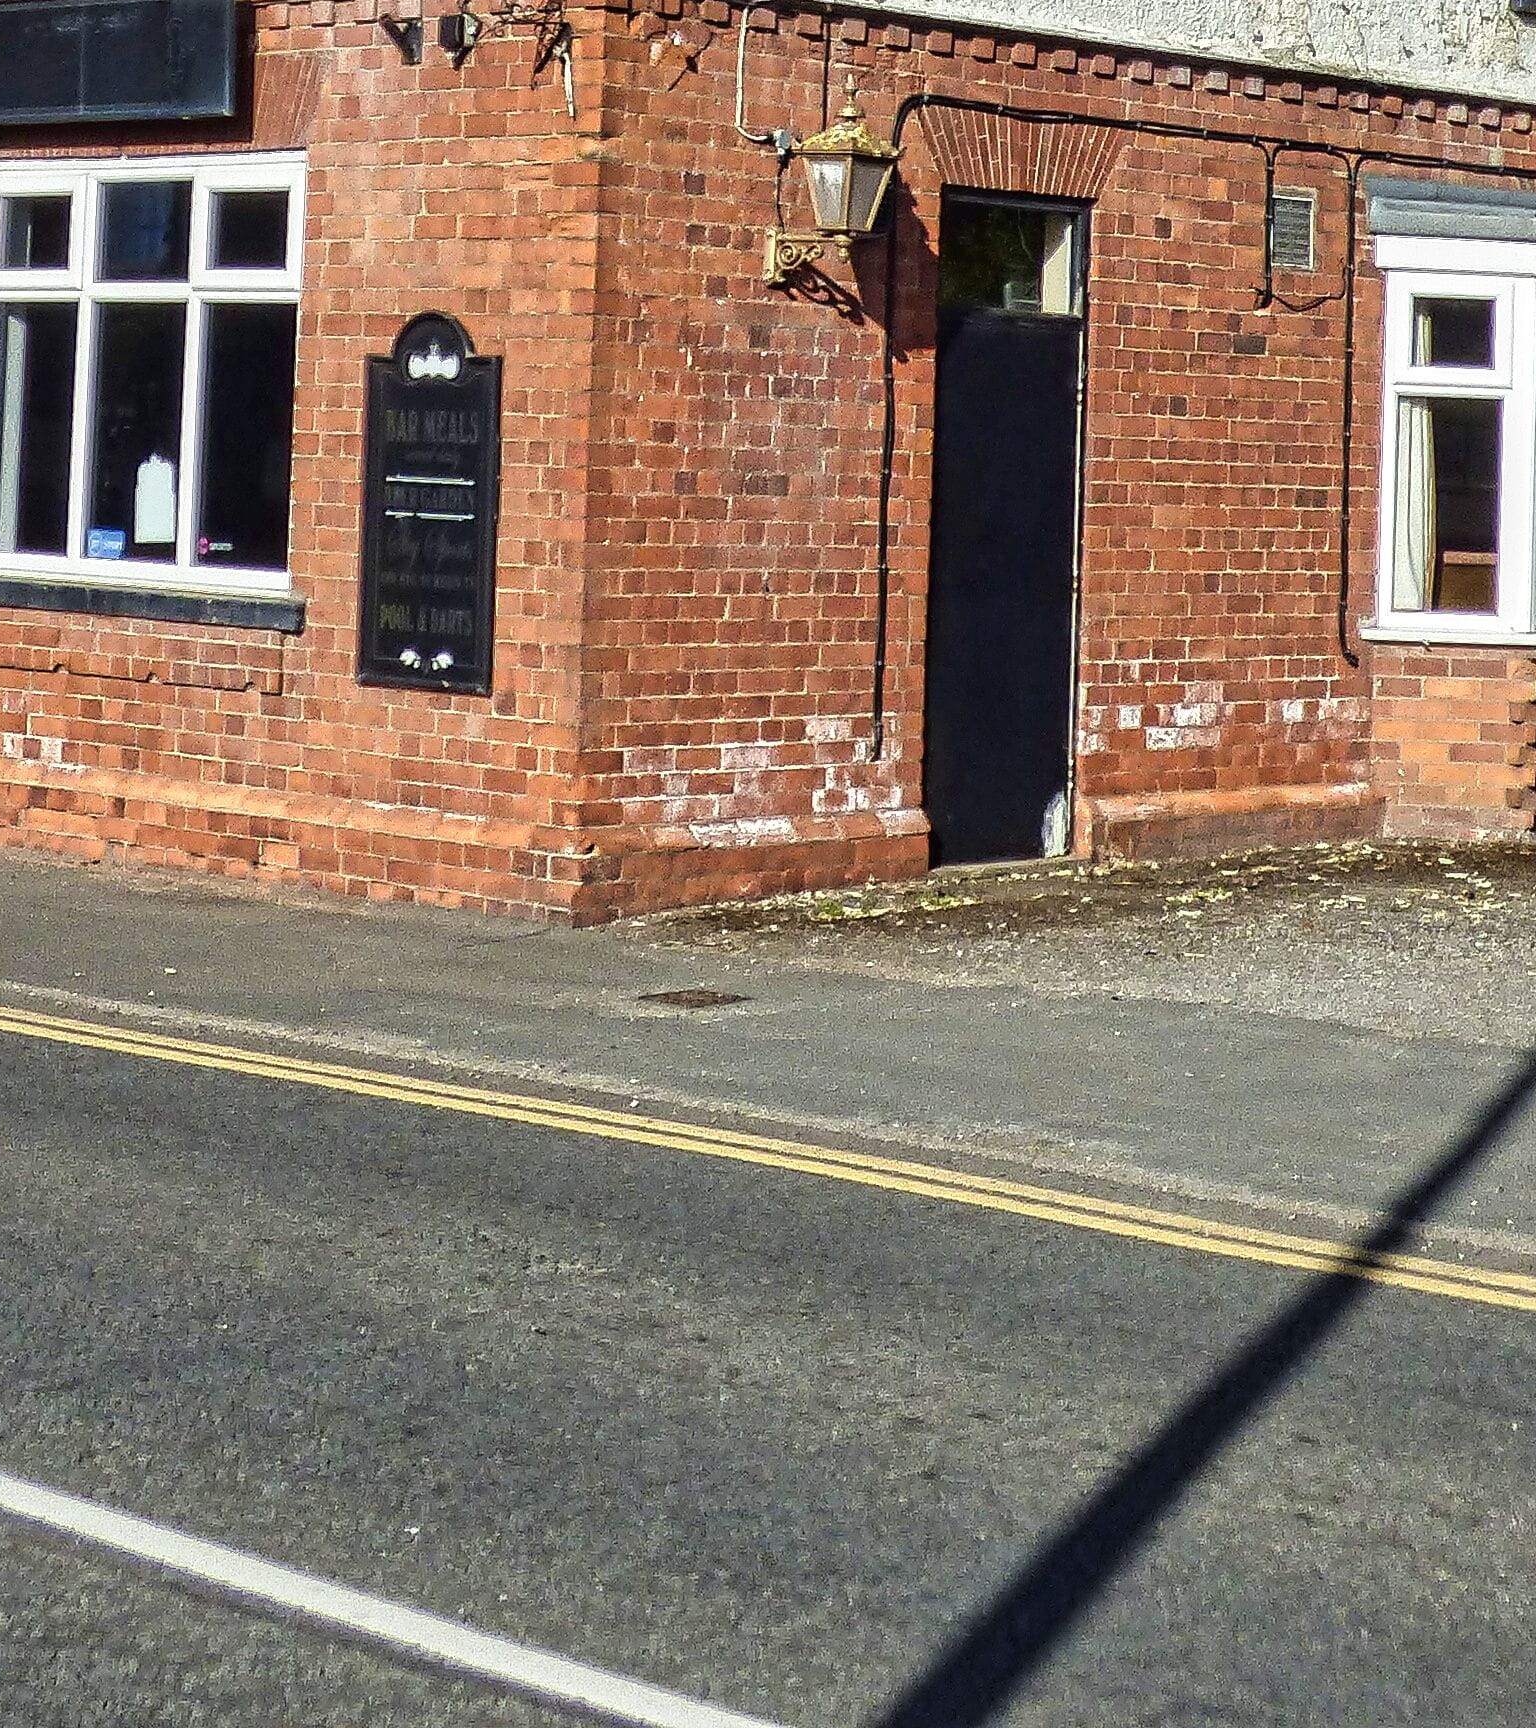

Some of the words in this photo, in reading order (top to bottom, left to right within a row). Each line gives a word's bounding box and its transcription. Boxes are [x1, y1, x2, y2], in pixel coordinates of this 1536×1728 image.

[385, 408, 418, 442] BAR
[422, 409, 480, 444] MEALS
[379, 603, 415, 633] POOL
[430, 608, 474, 637] DARTS
